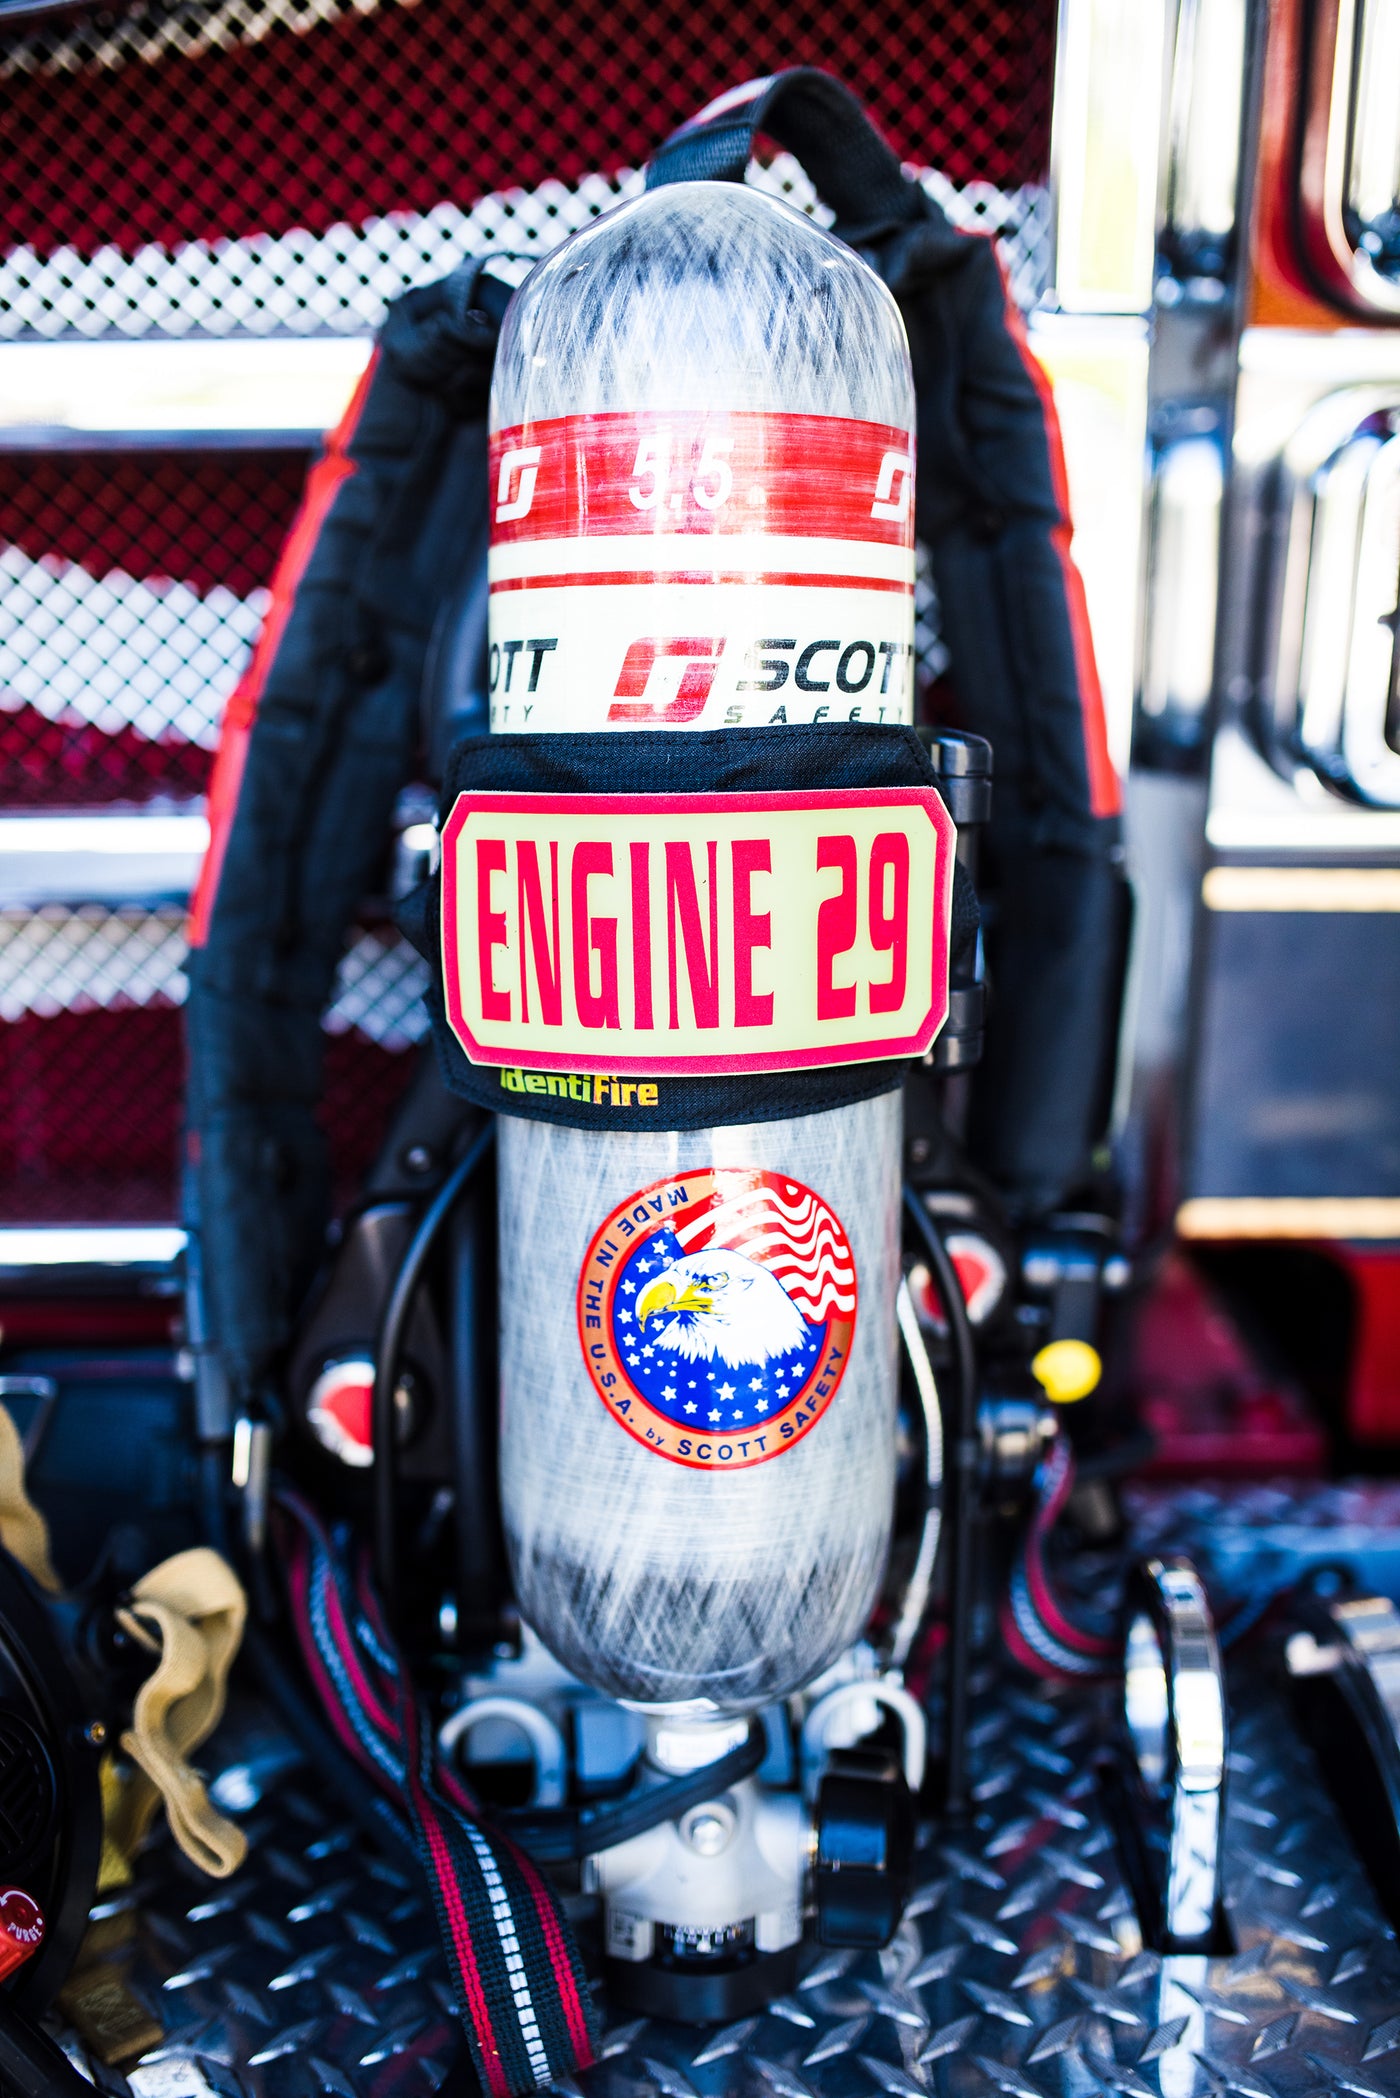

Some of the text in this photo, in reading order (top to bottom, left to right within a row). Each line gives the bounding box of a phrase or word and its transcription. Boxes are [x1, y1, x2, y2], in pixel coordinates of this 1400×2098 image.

[628, 438, 735, 510] 5.5
[476, 832, 910, 1030] ENGINE 29
[586, 1186, 844, 1460] MADE IN THE U.S.A. by SCOTT SAFETY
[7, 1922, 42, 1942] PURGE
